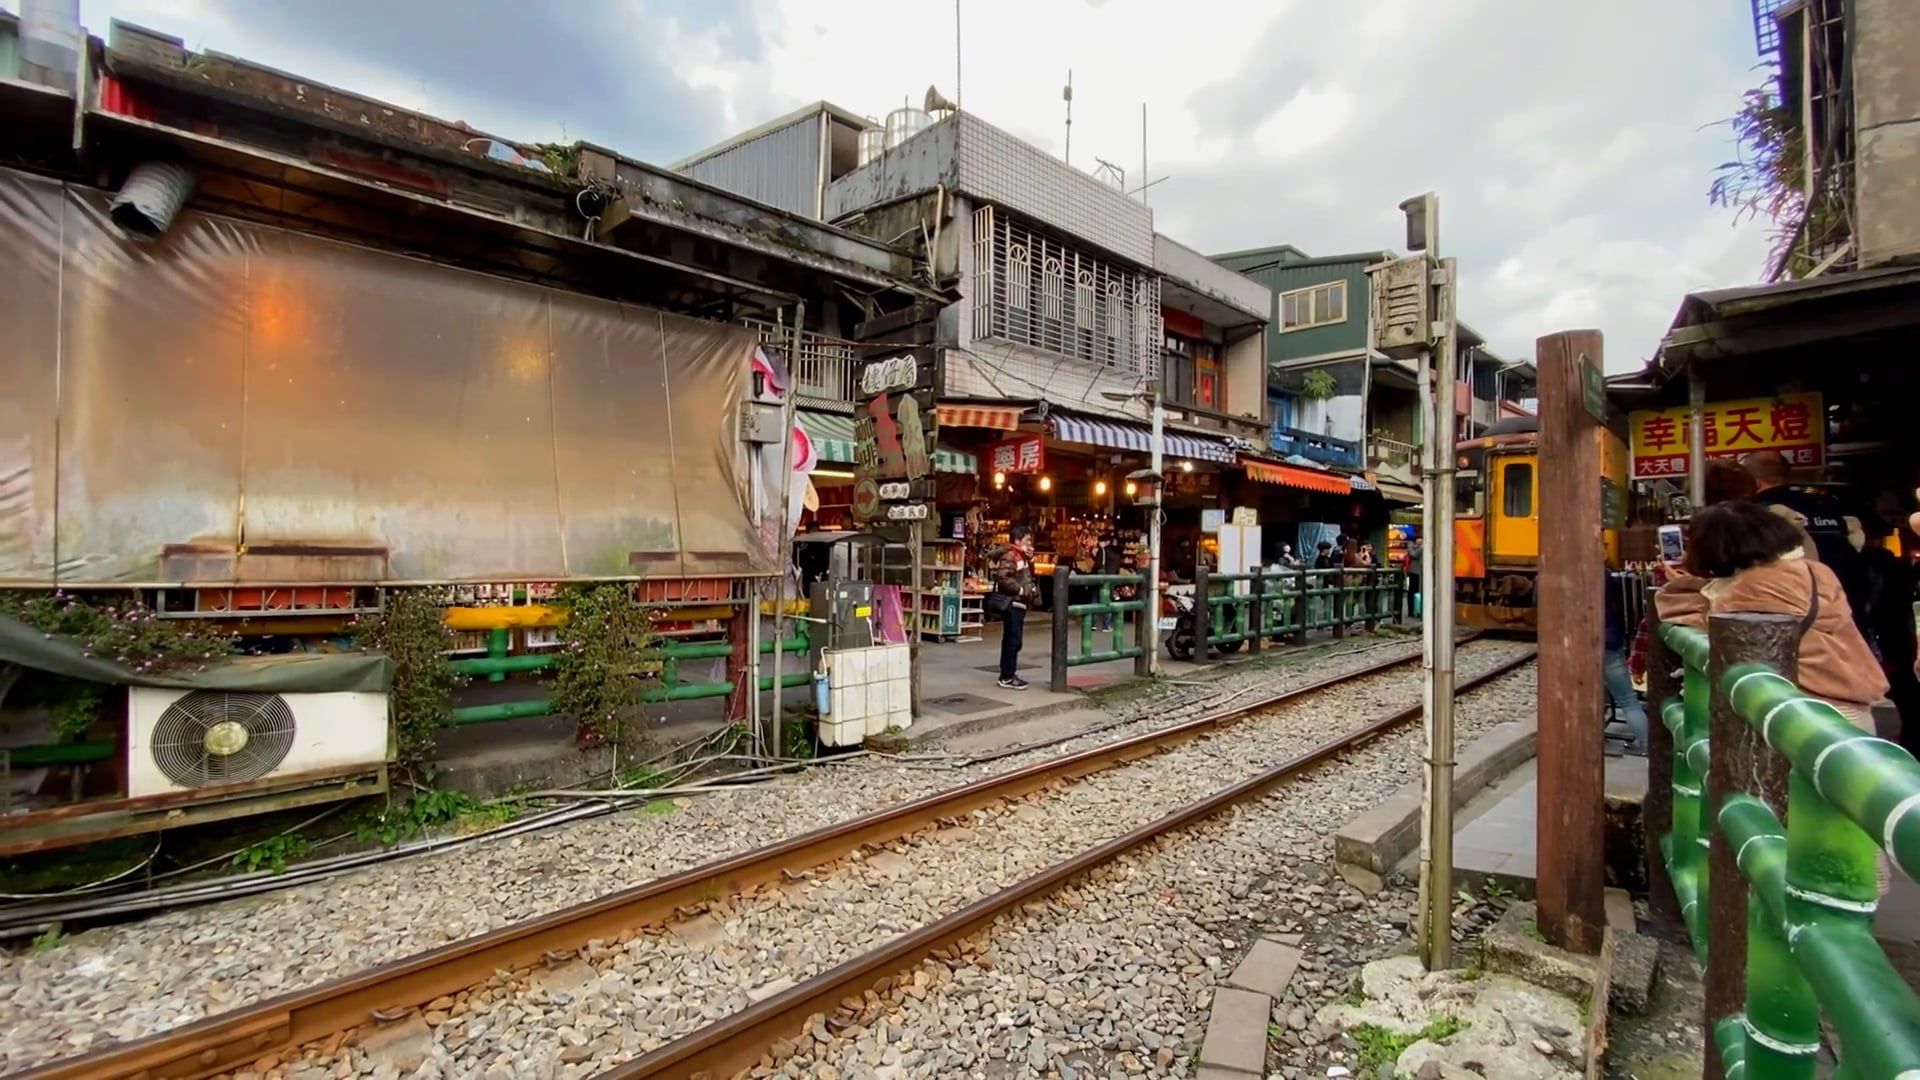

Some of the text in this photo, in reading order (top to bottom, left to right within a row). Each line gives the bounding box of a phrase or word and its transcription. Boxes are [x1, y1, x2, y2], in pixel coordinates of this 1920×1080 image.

[1642, 401, 1810, 452] 幸福天燈
[994, 440, 1040, 471] 藥房
